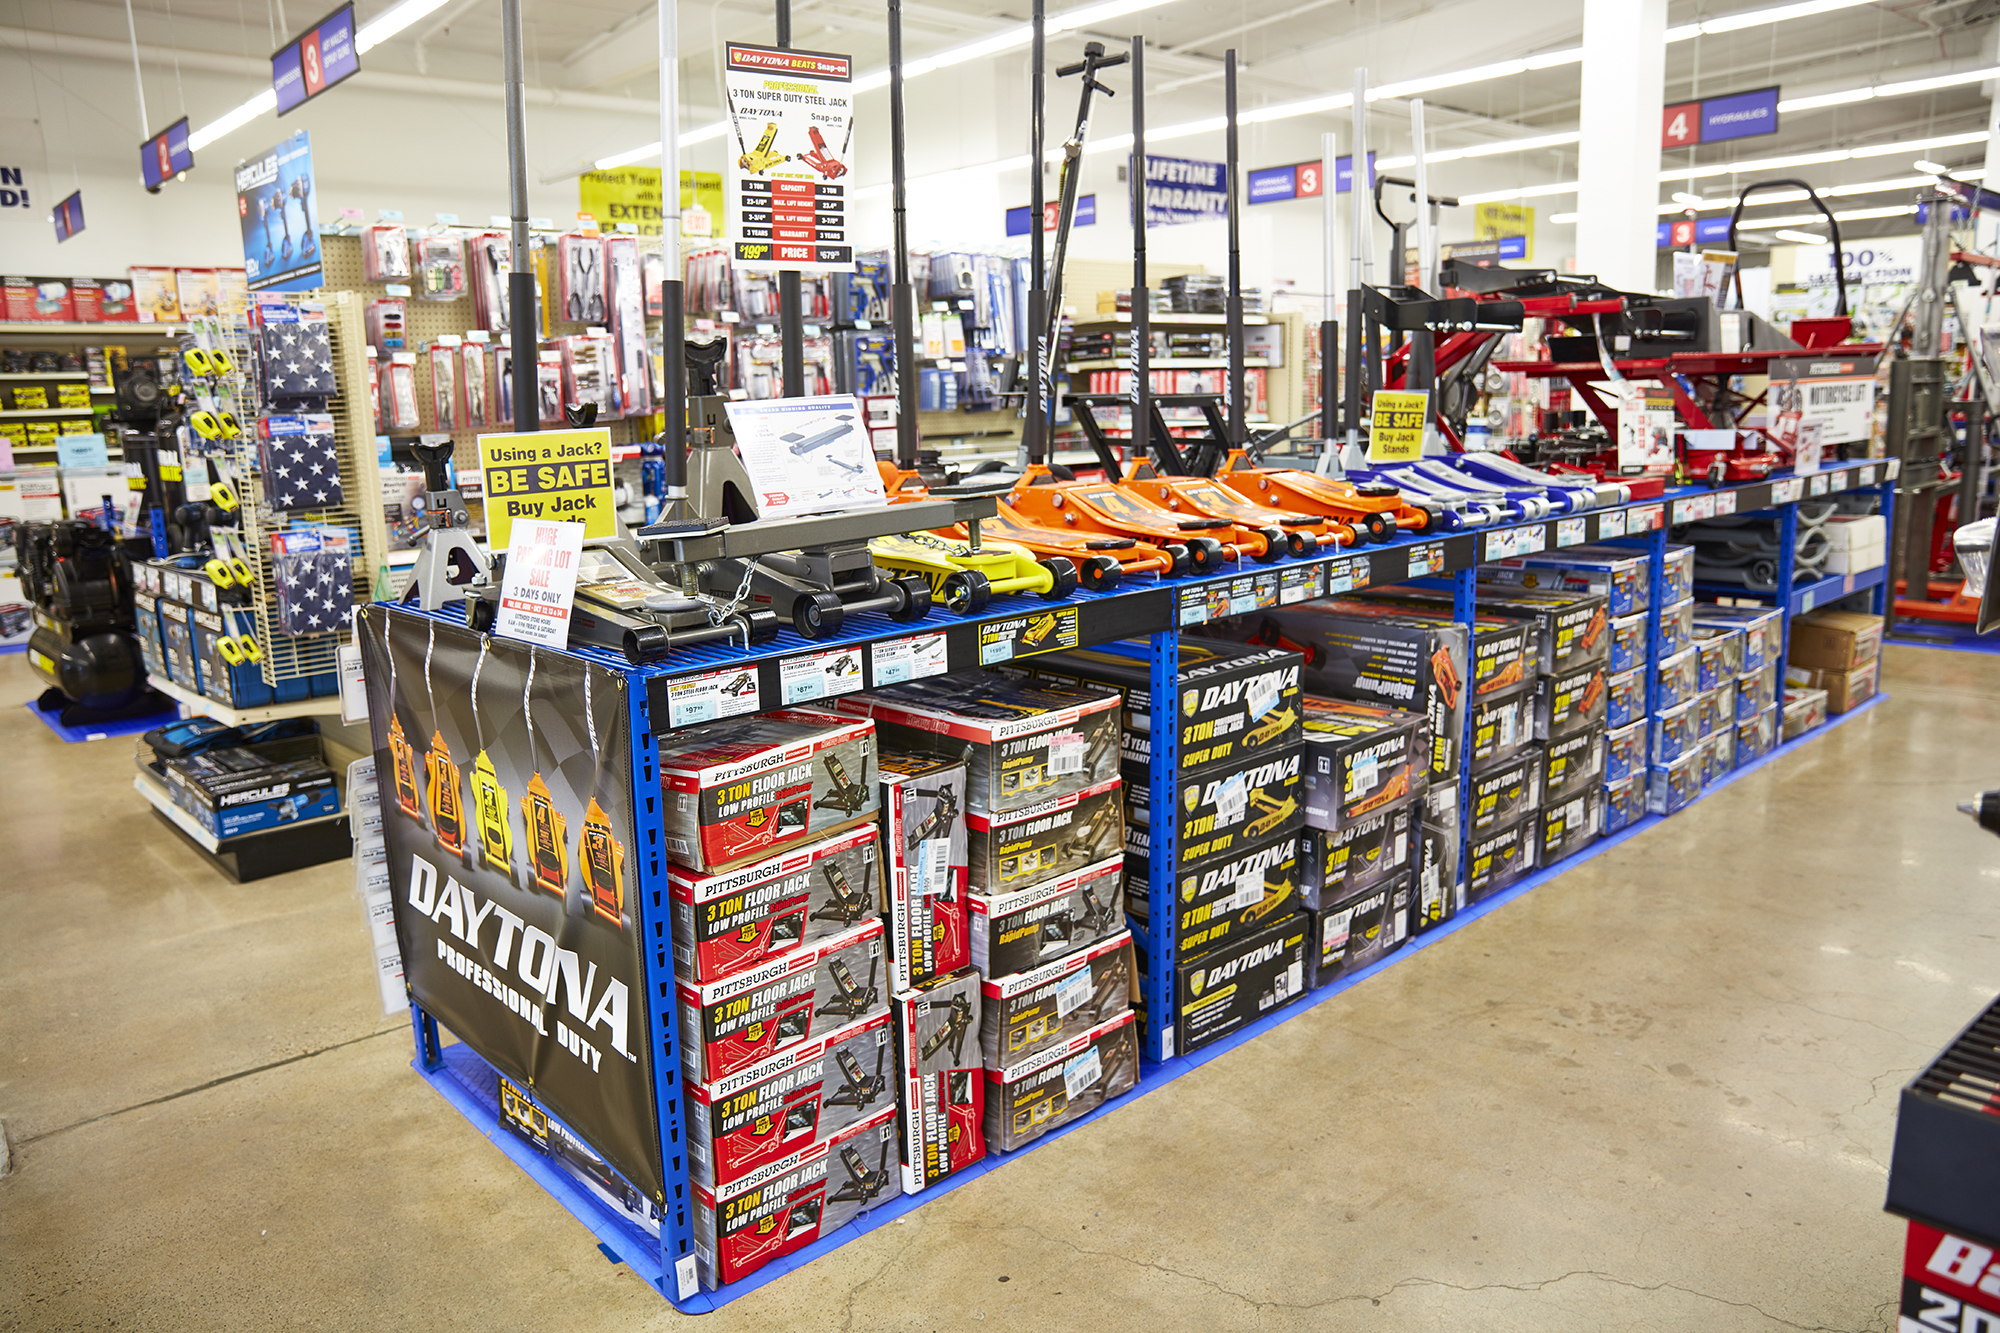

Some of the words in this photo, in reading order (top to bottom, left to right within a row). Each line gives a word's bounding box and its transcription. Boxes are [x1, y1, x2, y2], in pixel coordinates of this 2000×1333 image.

[307, 43, 319, 84] 3
[741, 54, 790, 67] DAYTONA
[791, 59, 816, 70] BEATS
[817, 62, 846, 73] Snap-on
[733, 89, 738, 97] 3
[740, 89, 755, 99] TON
[757, 91, 781, 101] SUPER
[784, 93, 803, 104] DUTY
[804, 95, 827, 106] STEEL
[828, 97, 847, 108] JACK
[763, 80, 819, 94] PROFESSIONAL
[740, 107, 783, 118] DAYTONA
[811, 113, 843, 123] Snap-on
[1667, 112, 1688, 141] 4
[160, 141, 169, 173] 2
[236, 154, 279, 193] HERCULES
[581, 172, 626, 185] Protect
[628, 174, 657, 186] Your
[1302, 168, 1317, 193] 3
[780, 184, 806, 192] CAPACITY
[798, 200, 813, 208] HEIGHT
[780, 230, 809, 238] WARRANTY
[825, 232, 840, 240] YEARS
[1676, 224, 1690, 243] 3
[781, 247, 808, 259] PRICE
[1378, 400, 1395, 409] Using
[1810, 386, 1852, 406] MOTORCYCLE
[1374, 412, 1390, 427] BE
[1393, 412, 1423, 428] SAFE
[1379, 432, 1393, 443] Buy
[1396, 432, 1415, 442] Jack
[1383, 444, 1409, 454] Stands
[490, 447, 537, 462] Using
[542, 447, 551, 458] a
[556, 442, 602, 457] Jack?
[489, 468, 529, 494] BE
[538, 462, 608, 490] SAFE
[507, 500, 544, 518] Buy
[551, 494, 597, 512] Jack
[535, 527, 558, 546] HUGE
[554, 550, 572, 569] LOT
[529, 568, 550, 588] SALE
[513, 586, 518, 596] 3
[520, 587, 539, 601] DAYS
[542, 590, 562, 604] ONLY
[982, 619, 1026, 634] DAYTONA
[1562, 608, 1594, 627] DAYTONA
[982, 635, 986, 644] 3
[987, 632, 999, 643] TON
[1482, 635, 1521, 657] DAYTONA
[1559, 672, 1592, 692] DAYTONA
[999, 715, 1058, 736] PITTSBURGH
[1009, 737, 1028, 755] TON
[1182, 748, 1210, 768] SUPER
[1211, 741, 1233, 760] DUTY
[1554, 735, 1588, 757] DAYTONA
[714, 752, 785, 782] PITTSBURGH
[729, 782, 751, 802] TON
[752, 775, 781, 795] FLOOR
[781, 763, 813, 786] JACK
[1483, 768, 1523, 795] DAYTONA
[220, 782, 291, 807] HERCULES
[484, 789, 494, 807] 3
[718, 801, 740, 818] LOW
[741, 790, 776, 811] PROFILE
[537, 805, 546, 824] 4
[996, 798, 1056, 823] PITTSBURGH
[1007, 823, 1025, 840] TON
[1026, 816, 1051, 836] FLOOR
[1051, 811, 1073, 828] JACK
[592, 835, 604, 850] 3
[1182, 843, 1210, 862] SUPER
[1211, 834, 1233, 852] DUTY
[1478, 828, 1518, 857] DAYTONA
[705, 862, 781, 897] PITTSBURGH
[1198, 838, 1296, 897] DAYTONA
[782, 871, 811, 894] JACK
[997, 884, 1056, 914] PITTSBURGH
[708, 919, 730, 936] LOW
[732, 905, 769, 929] PROFILE
[1006, 913, 1024, 931] TON
[1024, 905, 1049, 925] FLOOR
[1049, 896, 1071, 916] JACK
[898, 899, 908, 982] PITTSBURGH
[922, 909, 932, 956] PROFILE
[1181, 930, 1208, 951] SUPER
[1209, 920, 1231, 941] DUTY
[407, 852, 630, 1059] DAYTONA
[1206, 938, 1285, 989] DAYTONA
[1008, 964, 1066, 994] PITTSBURGH
[436, 937, 549, 1038] PROFESSIONAL
[556, 1020, 603, 1074] DUTY
[1017, 991, 1035, 1010] TON
[1010, 1044, 1068, 1079] PITTSBURGH
[719, 1054, 794, 1095] PITTSBURGH
[1021, 1073, 1038, 1093] TON
[732, 1089, 757, 1115] TON
[759, 1073, 794, 1101] FLOOR
[795, 1060, 824, 1084] JACK
[924, 1072, 936, 1103] JACK
[722, 1113, 745, 1132] LOW
[746, 1099, 784, 1124] PROFILE
[924, 1104, 938, 1141] FLOOR
[938, 1113, 948, 1156] PROFILE
[913, 1110, 922, 1186] PITTSBURGH
[723, 1154, 799, 1197] PITTSBURGH
[736, 1191, 761, 1215] TON
[763, 1175, 798, 1203] FLOOR
[799, 1158, 829, 1183] JACK
[726, 1214, 749, 1233] LOW
[750, 1199, 788, 1225] PROFILE
